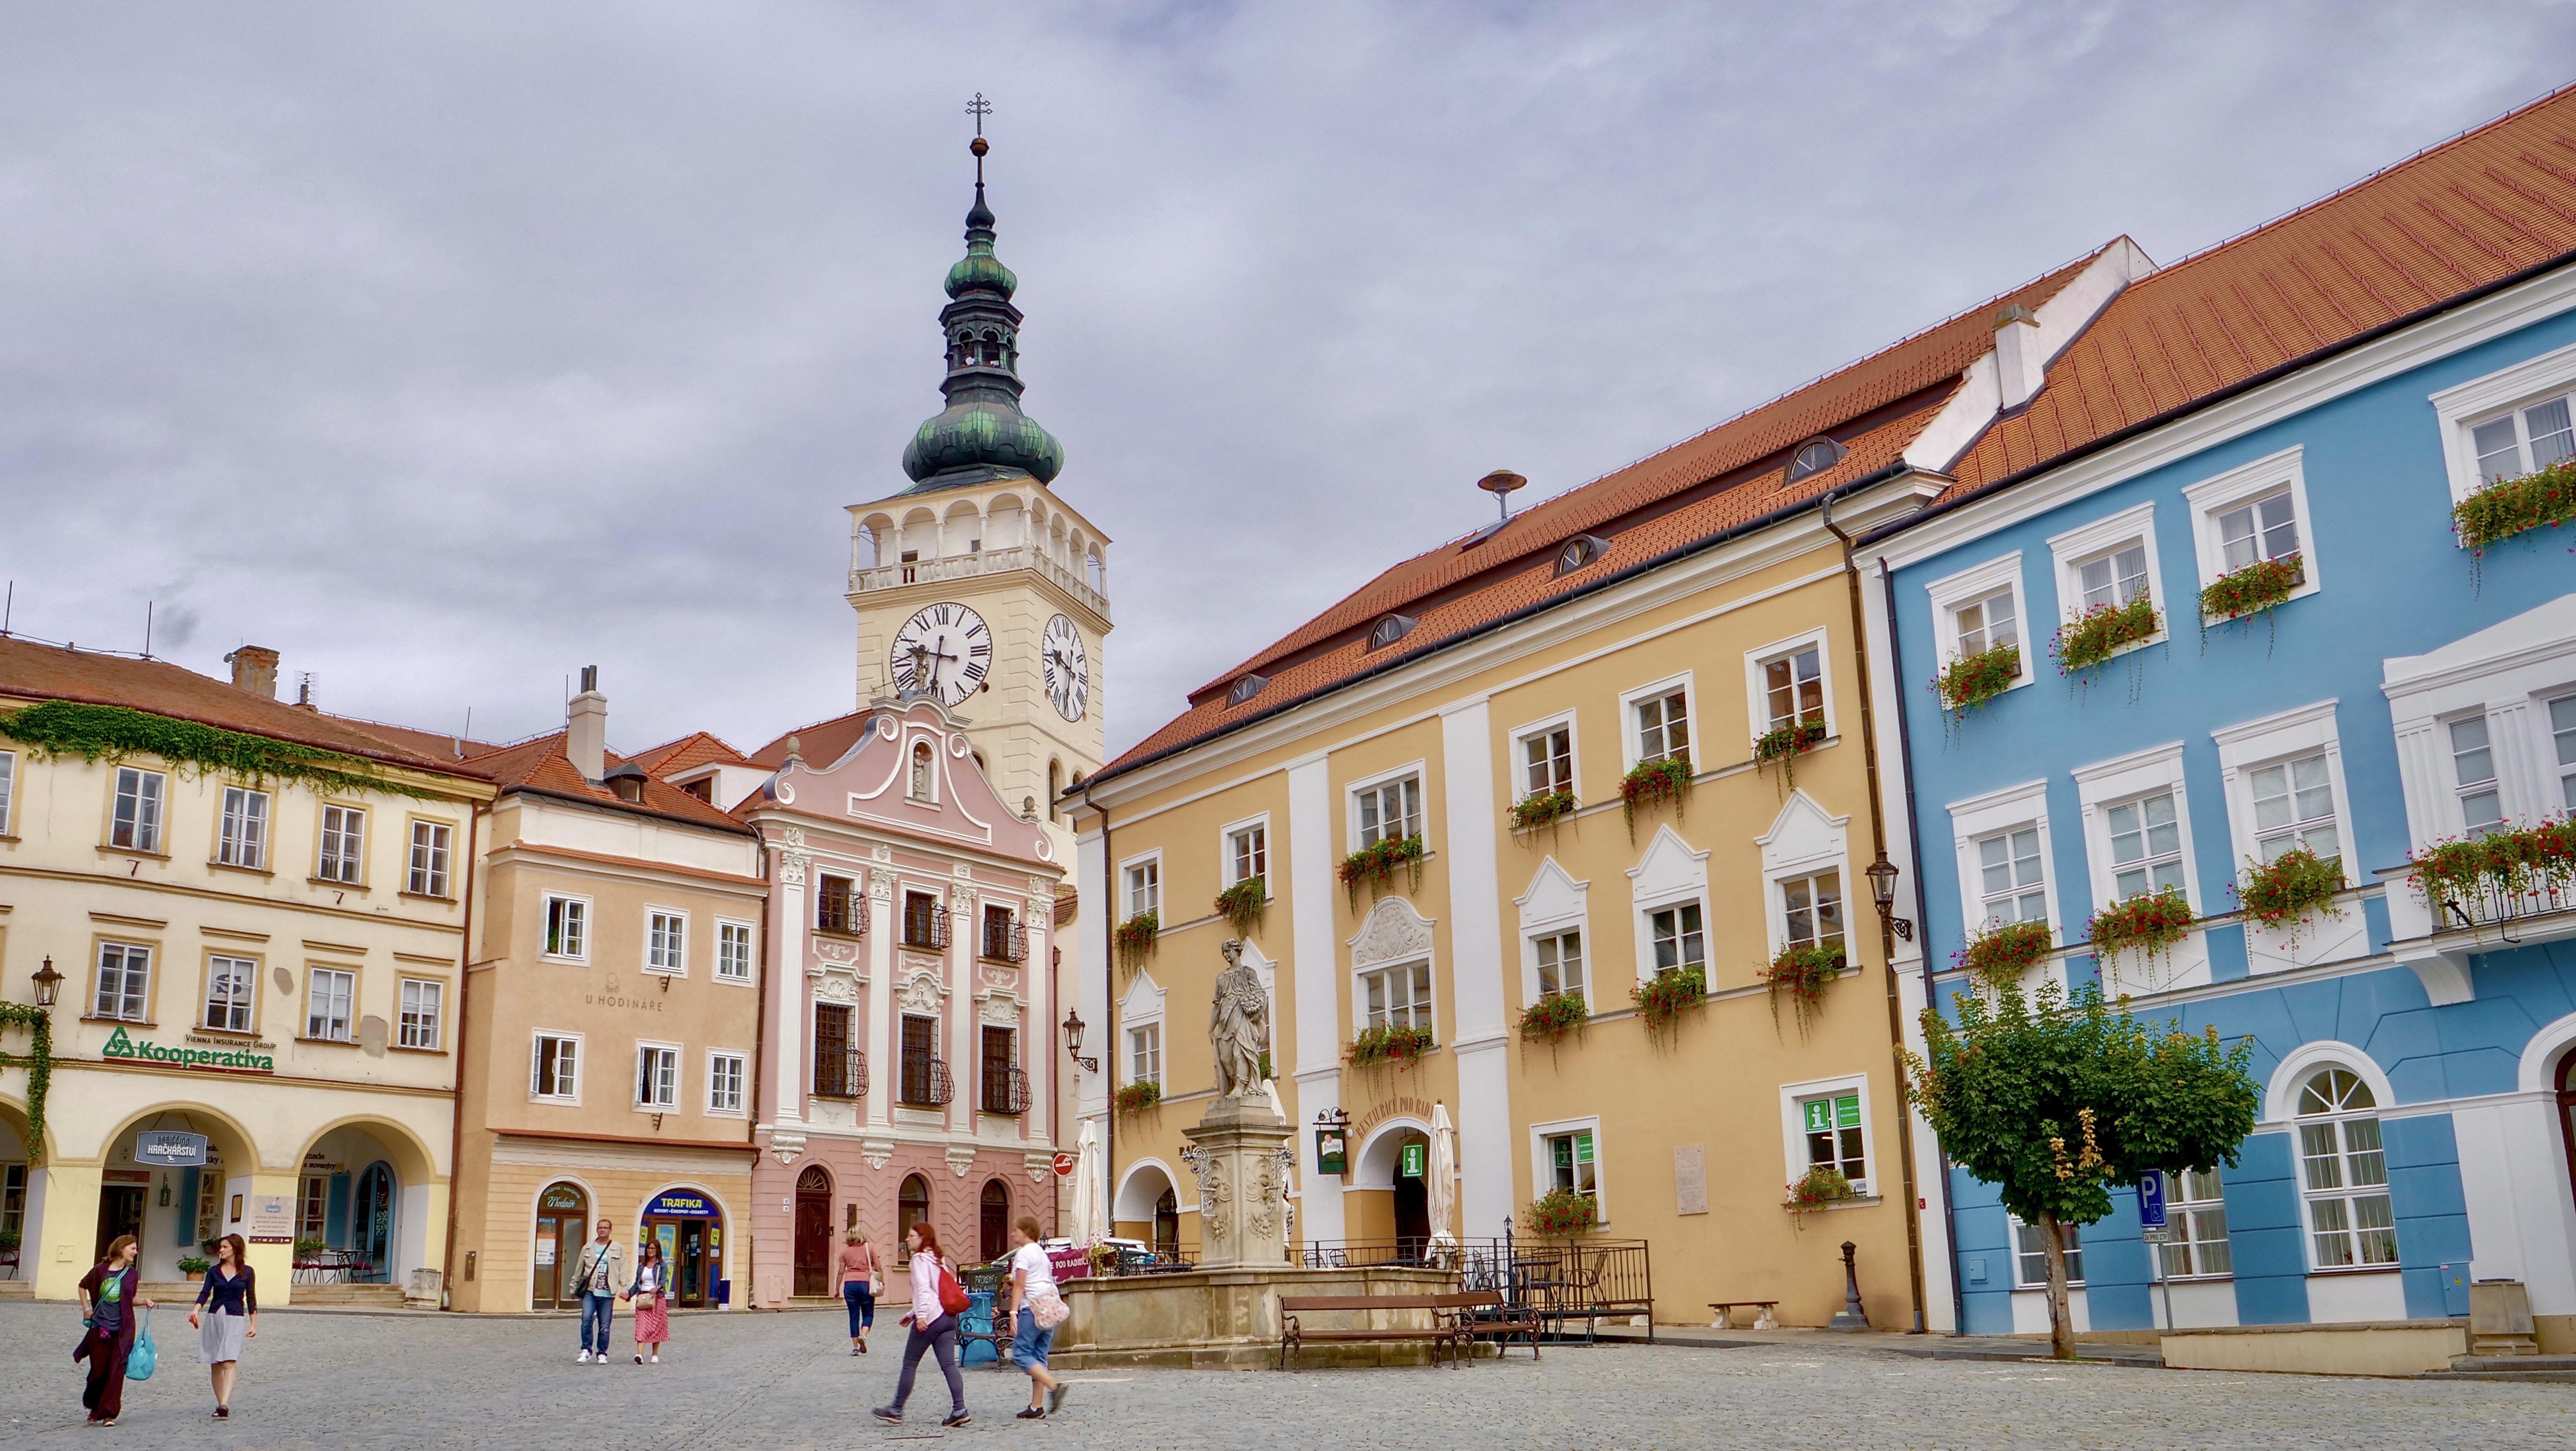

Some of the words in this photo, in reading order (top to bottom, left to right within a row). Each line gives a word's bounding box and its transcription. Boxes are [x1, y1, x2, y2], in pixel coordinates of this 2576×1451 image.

[914, 614, 931, 636] XI
[934, 607, 949, 627] XII
[965, 624, 982, 640] II
[970, 645, 988, 657] III
[1076, 653, 1084, 663] II
[963, 662, 984, 681] IIII
[1078, 671, 1087, 686] III
[955, 681, 967, 698] V
[586, 995, 592, 1004] U
[598, 996, 663, 1012] HODINÁŘE
[139, 1041, 274, 1069] Kooperativa
[1400, 1097, 1413, 1113] POD
[148, 1143, 197, 1156] HRAČKÁŘSTVÍ
[2141, 1176, 2157, 1209] P
[661, 1198, 702, 1208] TRAFIKA
